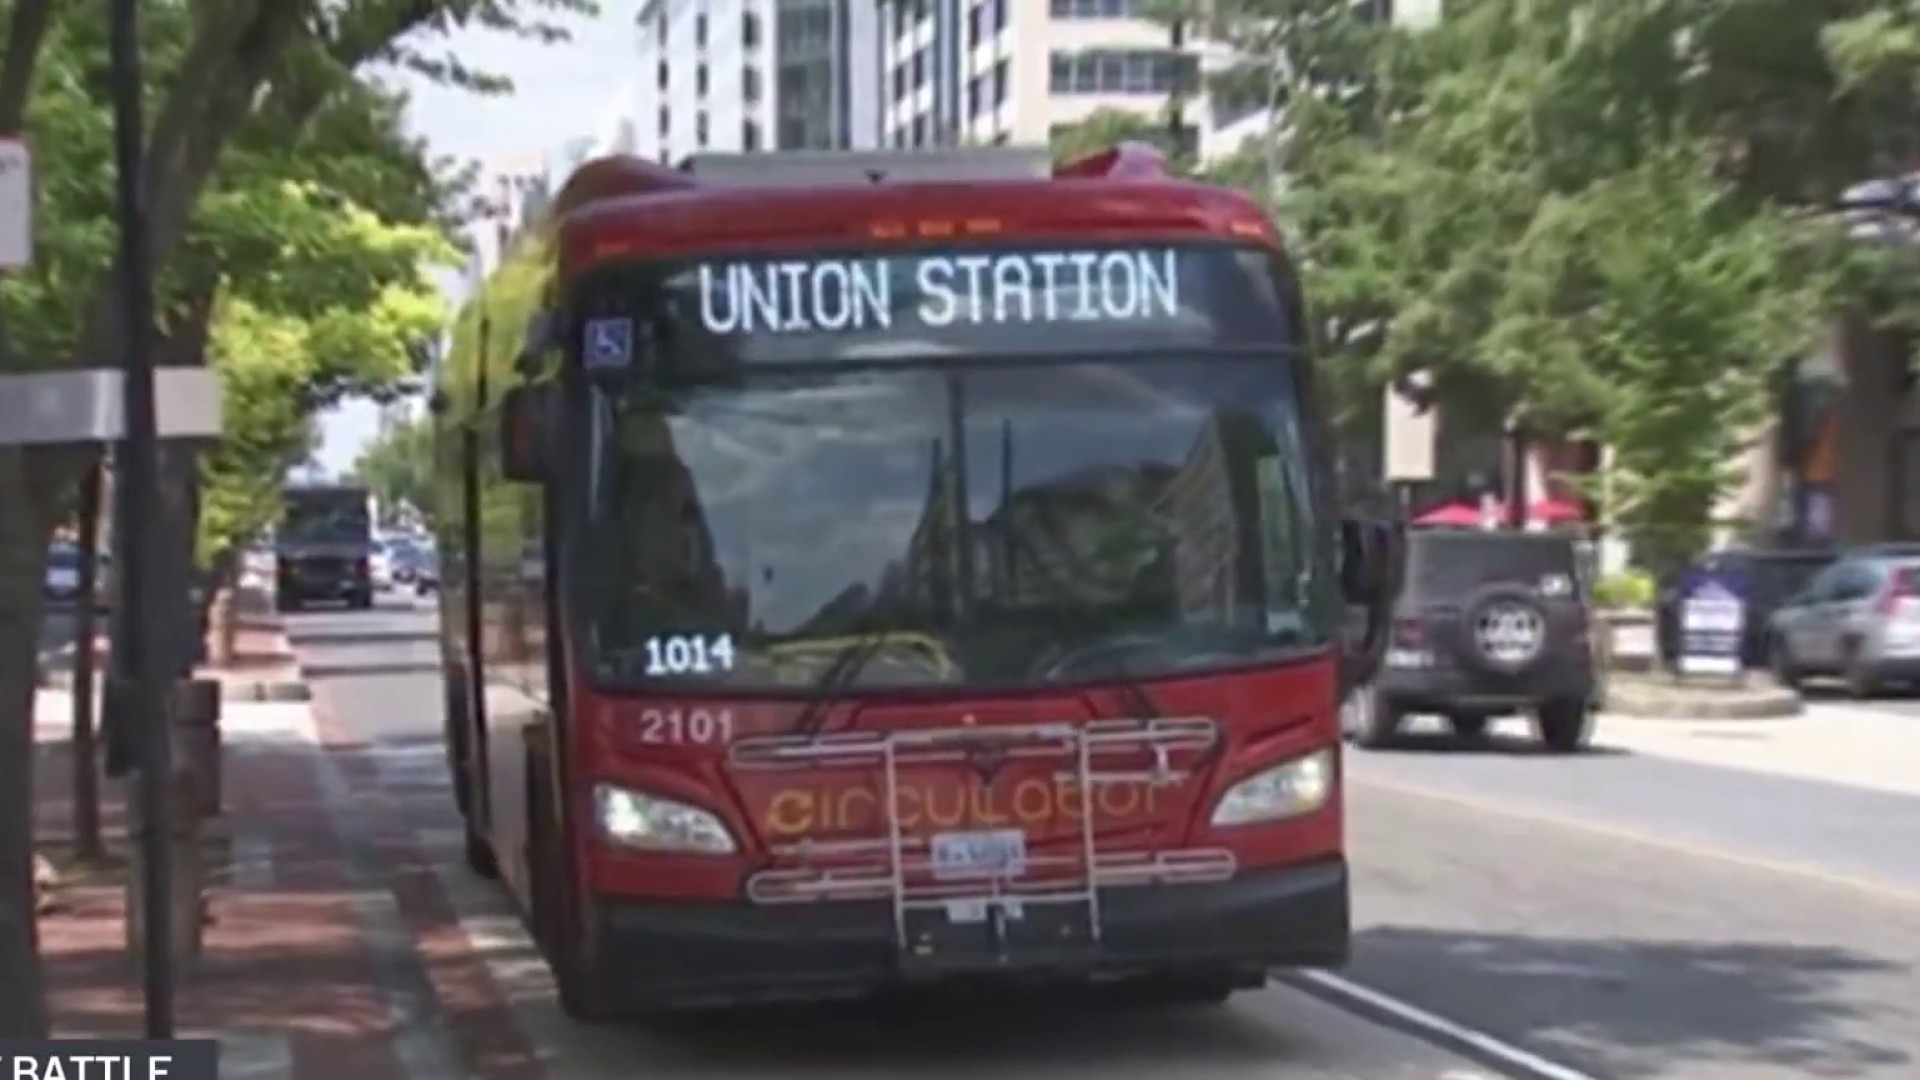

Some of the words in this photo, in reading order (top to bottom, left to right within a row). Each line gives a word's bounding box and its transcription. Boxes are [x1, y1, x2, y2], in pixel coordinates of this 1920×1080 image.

[700, 258, 892, 333] UNION
[915, 248, 1179, 327] STATION
[644, 632, 734, 676] 1014
[641, 707, 733, 745] 2101
